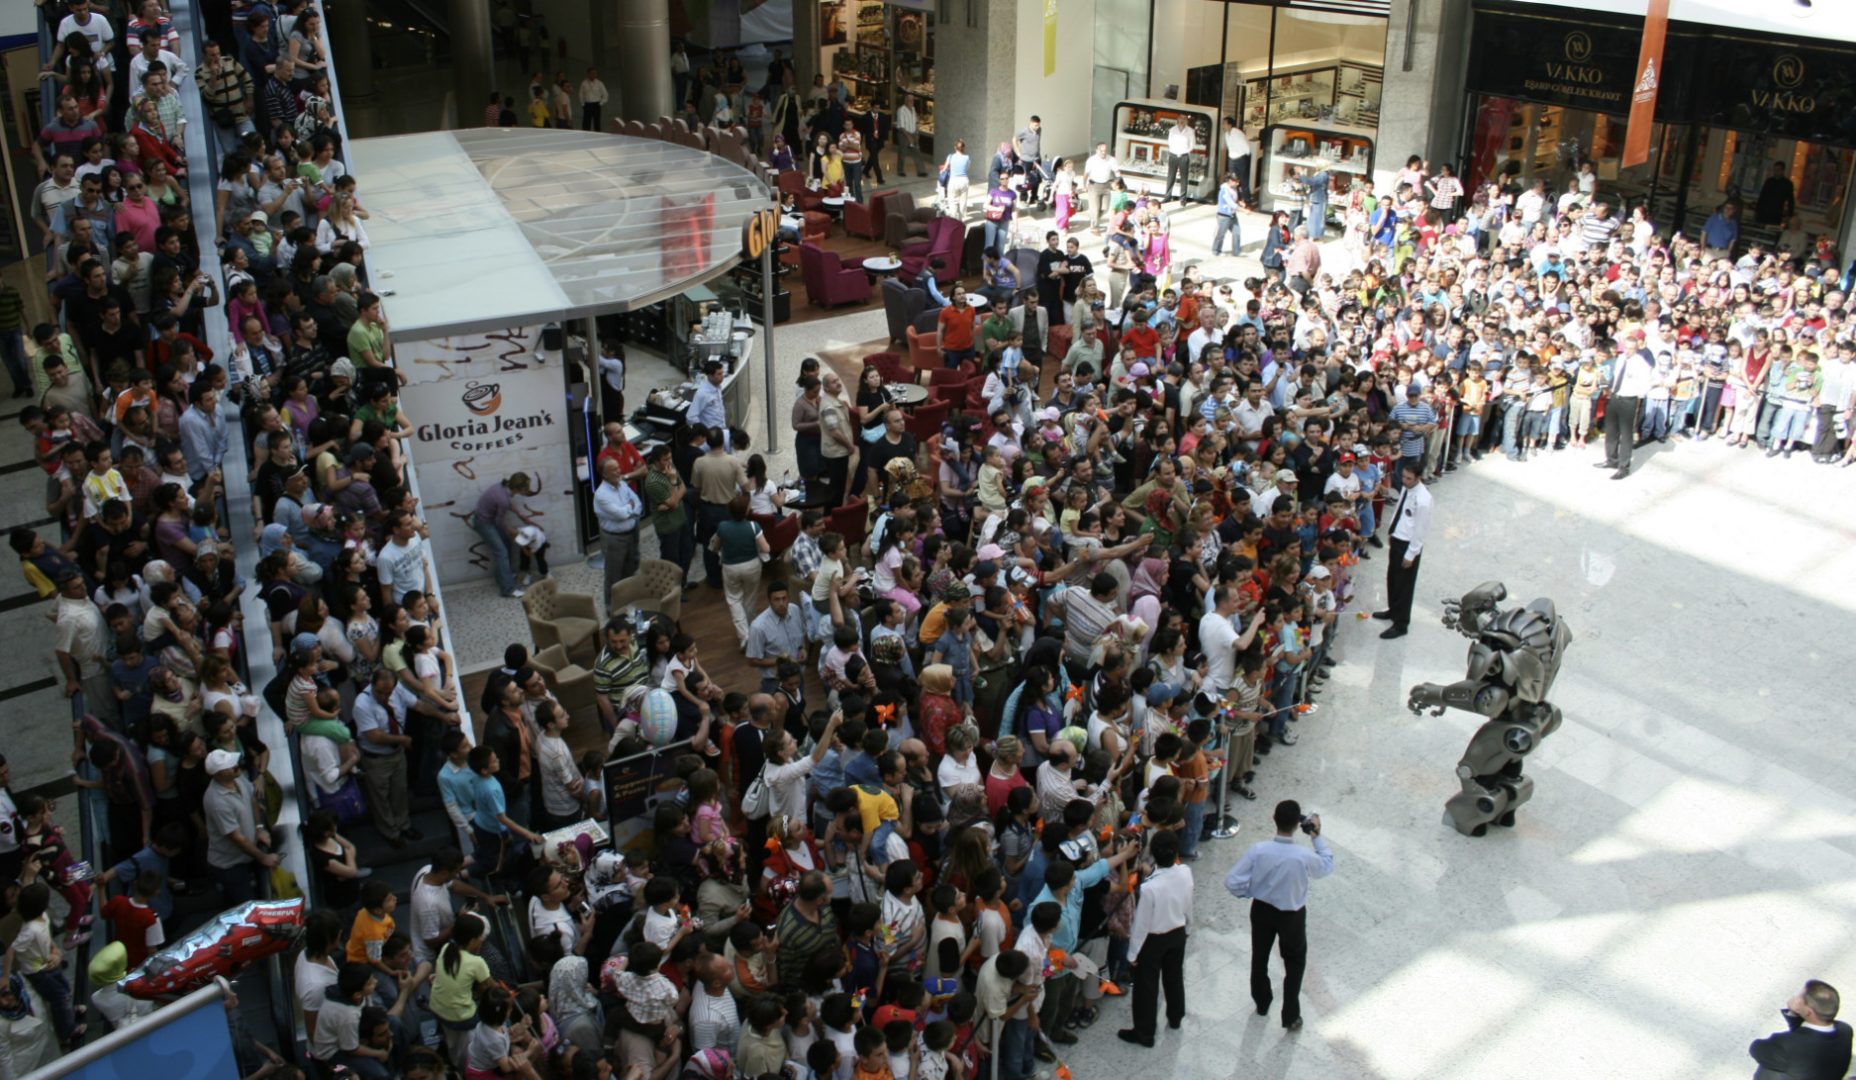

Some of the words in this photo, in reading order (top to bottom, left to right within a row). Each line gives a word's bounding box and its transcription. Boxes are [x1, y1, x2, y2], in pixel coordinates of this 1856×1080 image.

[1546, 62, 1602, 84] VAKKO
[1751, 89, 1816, 113] VAKKO
[417, 419, 488, 442] Gloria
[493, 409, 553, 433] Jean's
[450, 433, 524, 451] COFFEES
